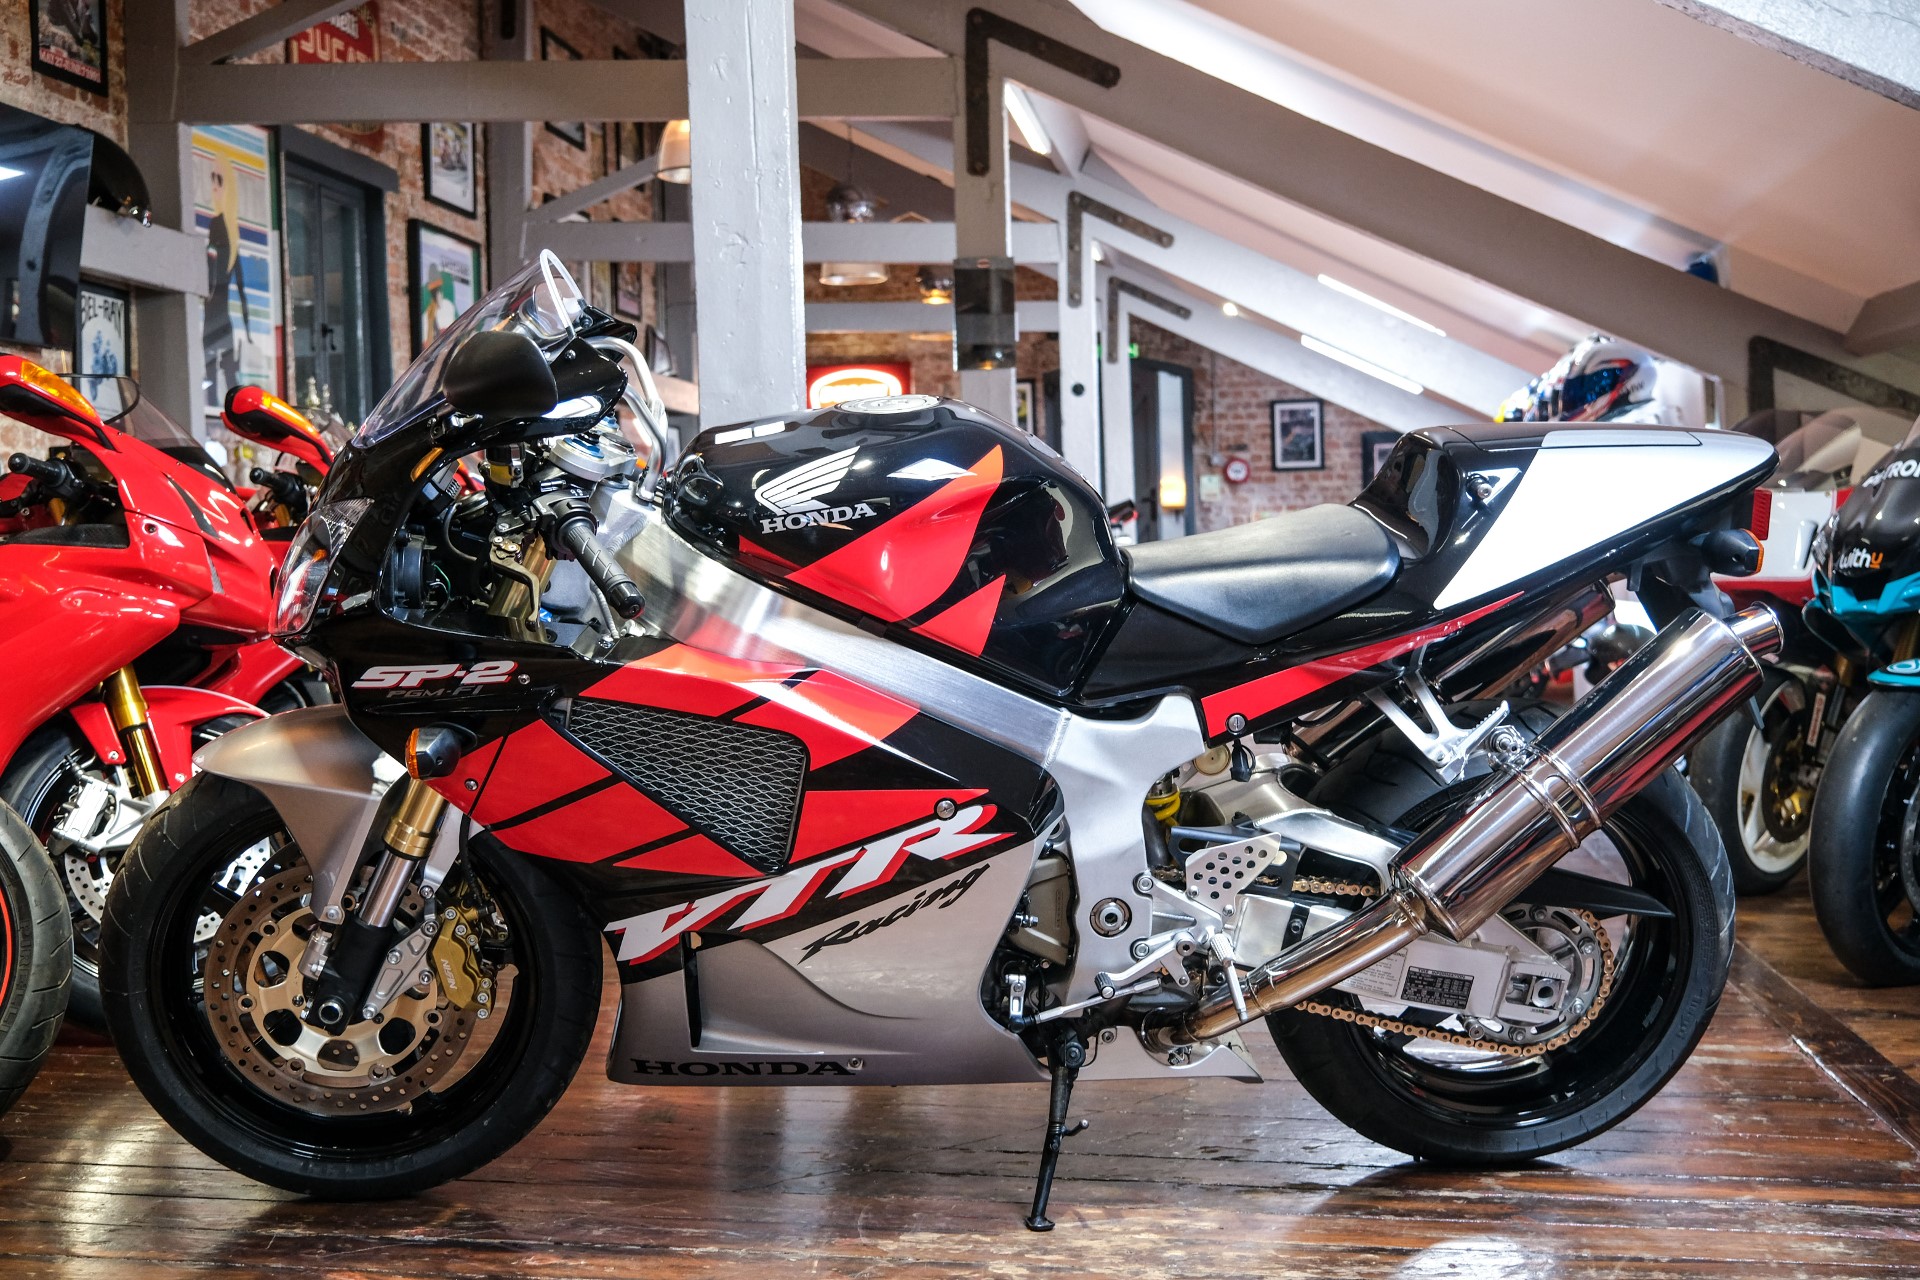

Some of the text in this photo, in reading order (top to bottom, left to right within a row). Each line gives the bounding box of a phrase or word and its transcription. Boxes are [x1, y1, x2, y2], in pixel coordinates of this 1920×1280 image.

[760, 503, 877, 534] HONDA
[351, 660, 518, 689] SP-2
[386, 684, 484, 698] PGM-FI
[603, 804, 1015, 966] VTR
[798, 863, 991, 966] Racing
[629, 1058, 857, 1077] HONDA
